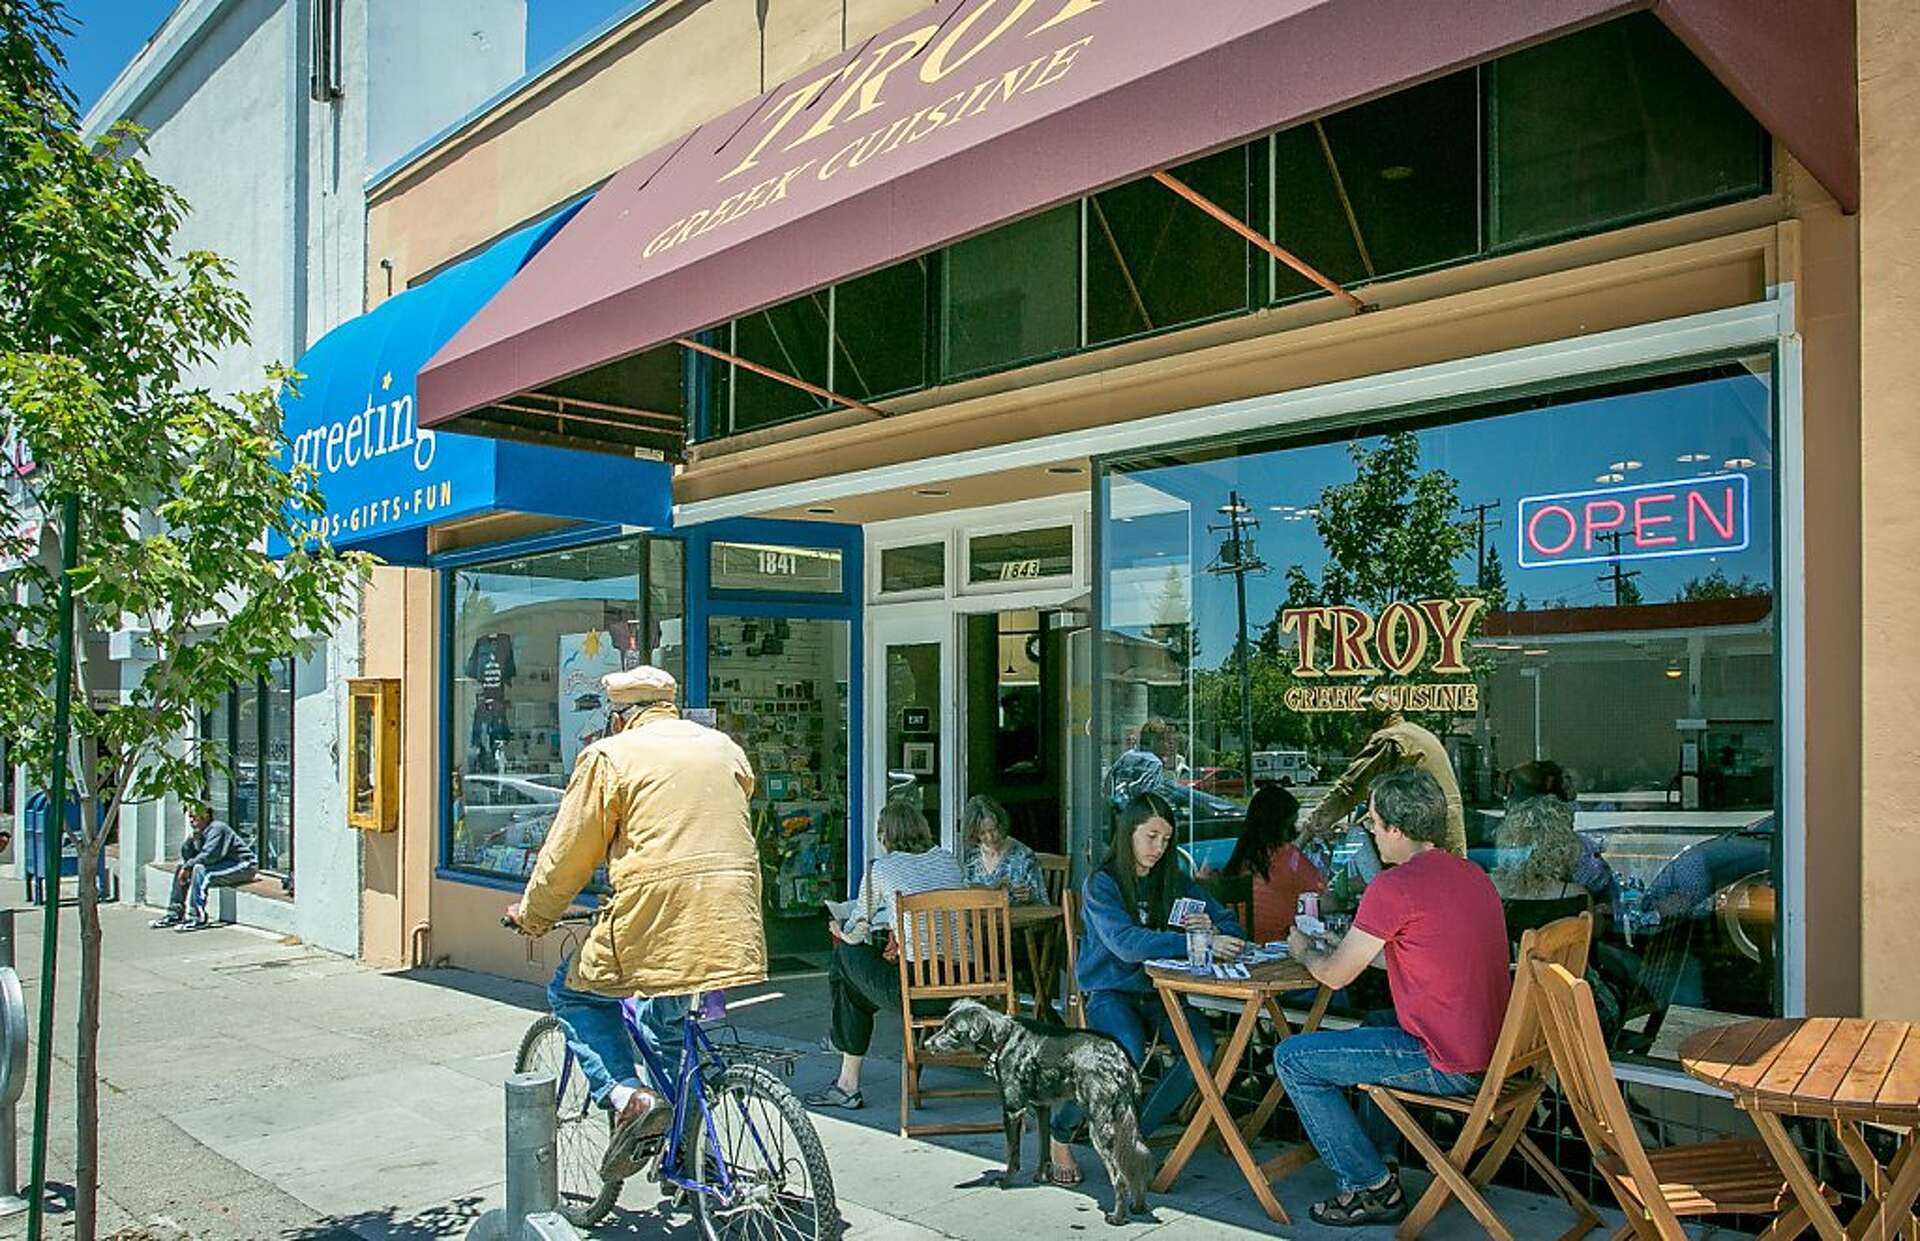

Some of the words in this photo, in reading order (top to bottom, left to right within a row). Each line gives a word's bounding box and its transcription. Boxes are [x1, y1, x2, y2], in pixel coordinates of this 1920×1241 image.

[717, 0, 1102, 182] TRO
[642, 160, 816, 259] GREEK
[817, 36, 1094, 181] CUISINE
[290, 513, 340, 547] RDS
[350, 496, 401, 532] GIFTS
[413, 480, 451, 514] FUN
[1527, 486, 1734, 555] OPEN
[757, 550, 797, 575] 1841
[1001, 560, 1040, 580] 1843
[1282, 597, 1486, 678] TROY
[1284, 685, 1366, 712] GREEK
[1371, 683, 1479, 712] CUISINE
